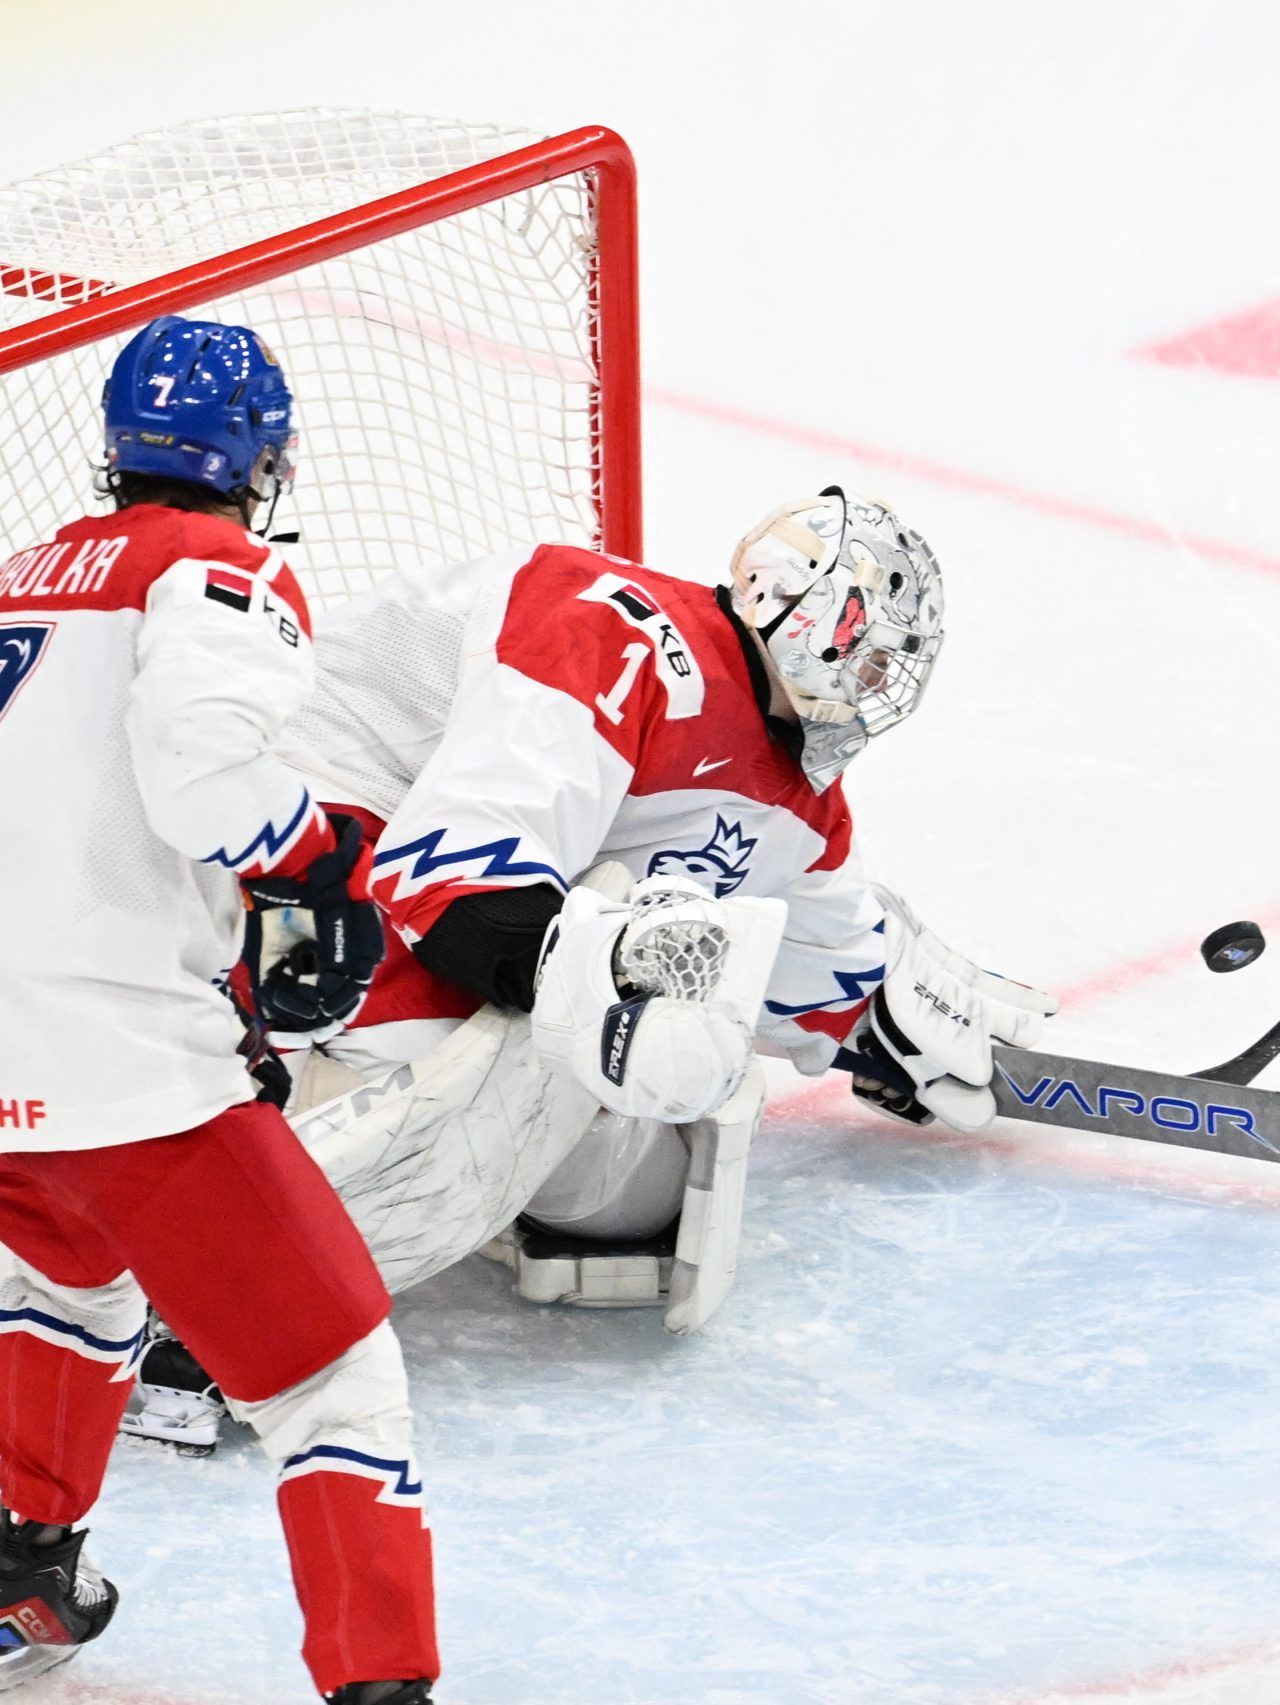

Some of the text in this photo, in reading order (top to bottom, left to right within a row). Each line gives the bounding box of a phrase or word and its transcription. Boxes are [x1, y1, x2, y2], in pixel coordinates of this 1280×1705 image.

[154, 376, 175, 408] 7
[595, 642, 651, 726] 1
[659, 624, 691, 677] KB
[995, 1060, 1280, 1154] VAPOR
